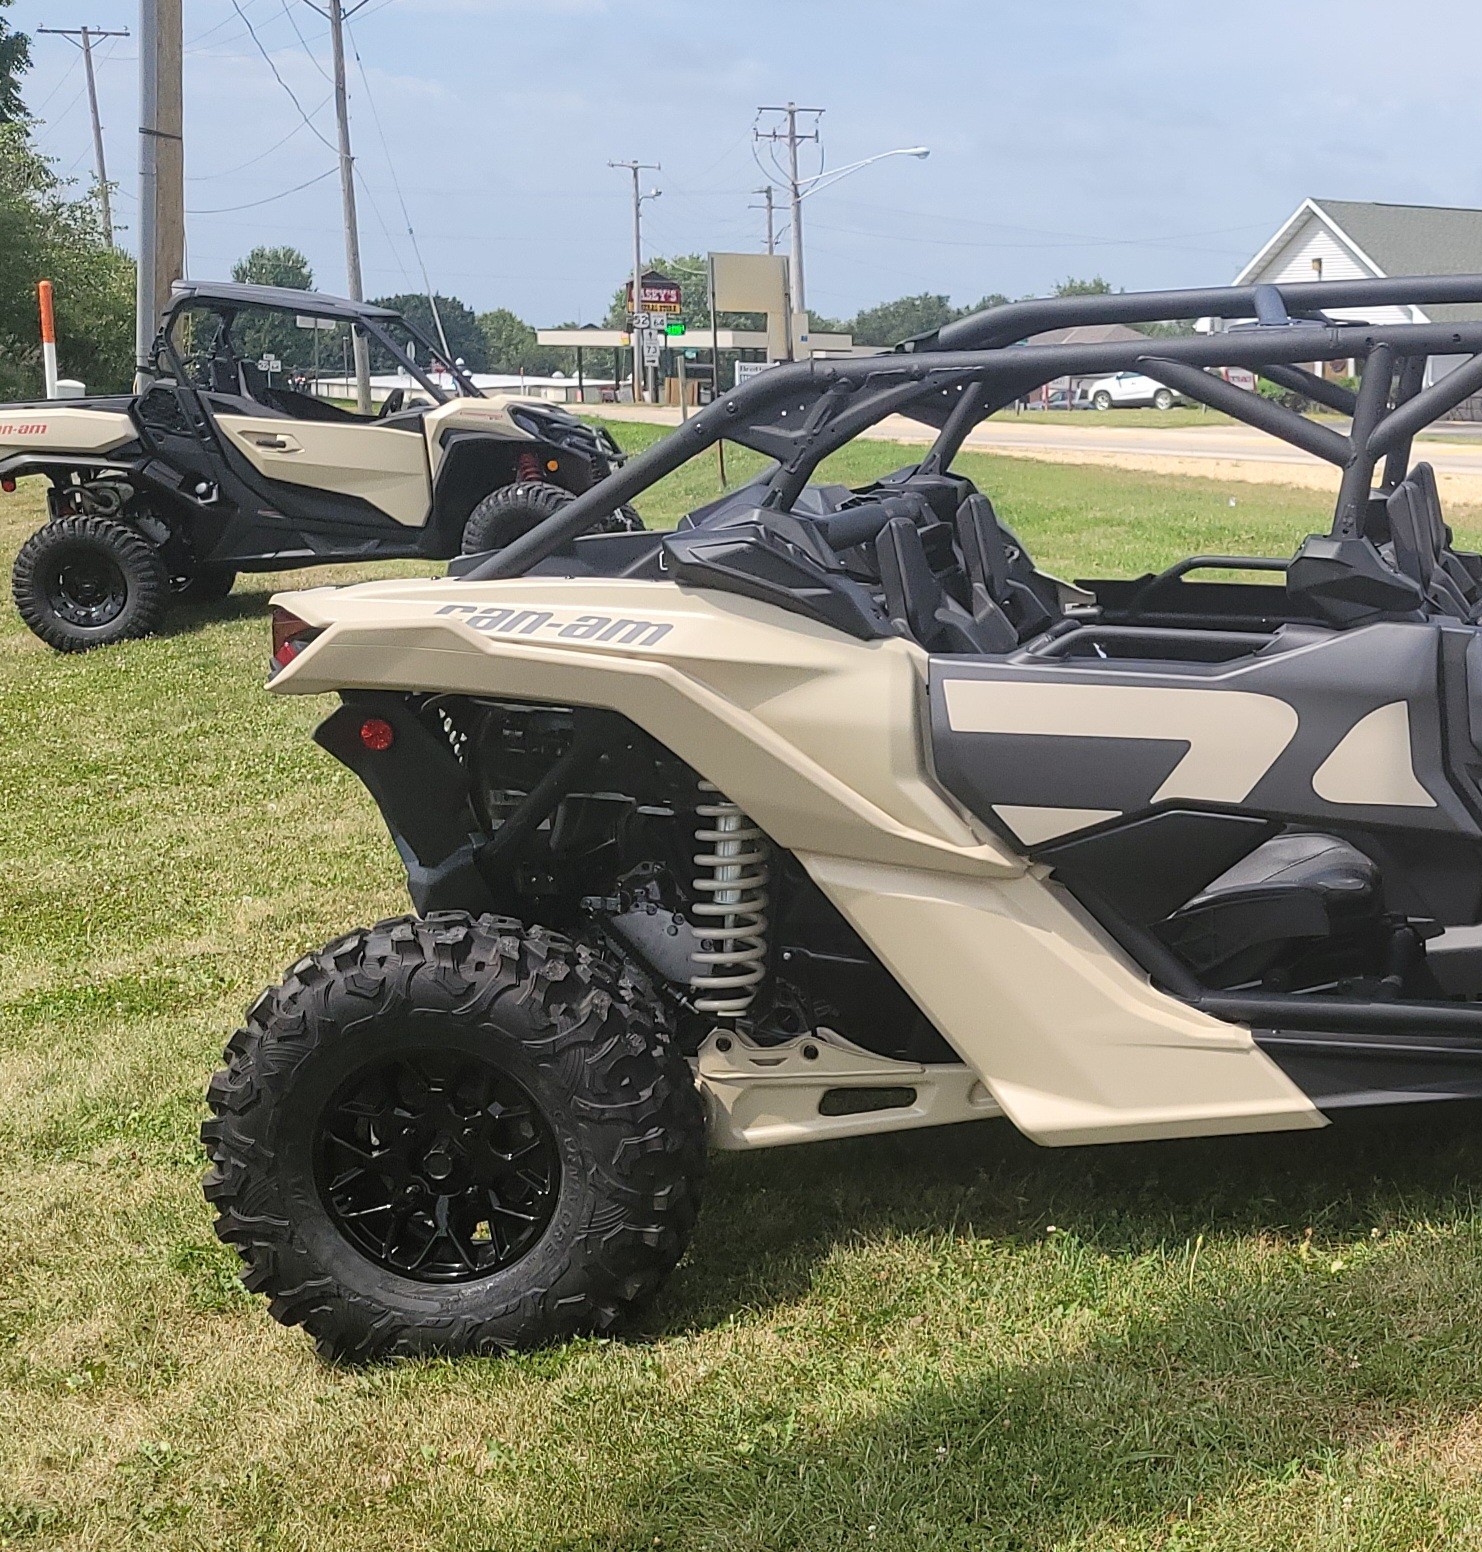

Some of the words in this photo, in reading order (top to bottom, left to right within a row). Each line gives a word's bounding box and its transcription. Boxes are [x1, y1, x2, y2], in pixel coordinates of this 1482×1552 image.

[632, 287, 677, 302] ASEY'S
[634, 314, 648, 325] 52
[0, 424, 47, 434] n-am
